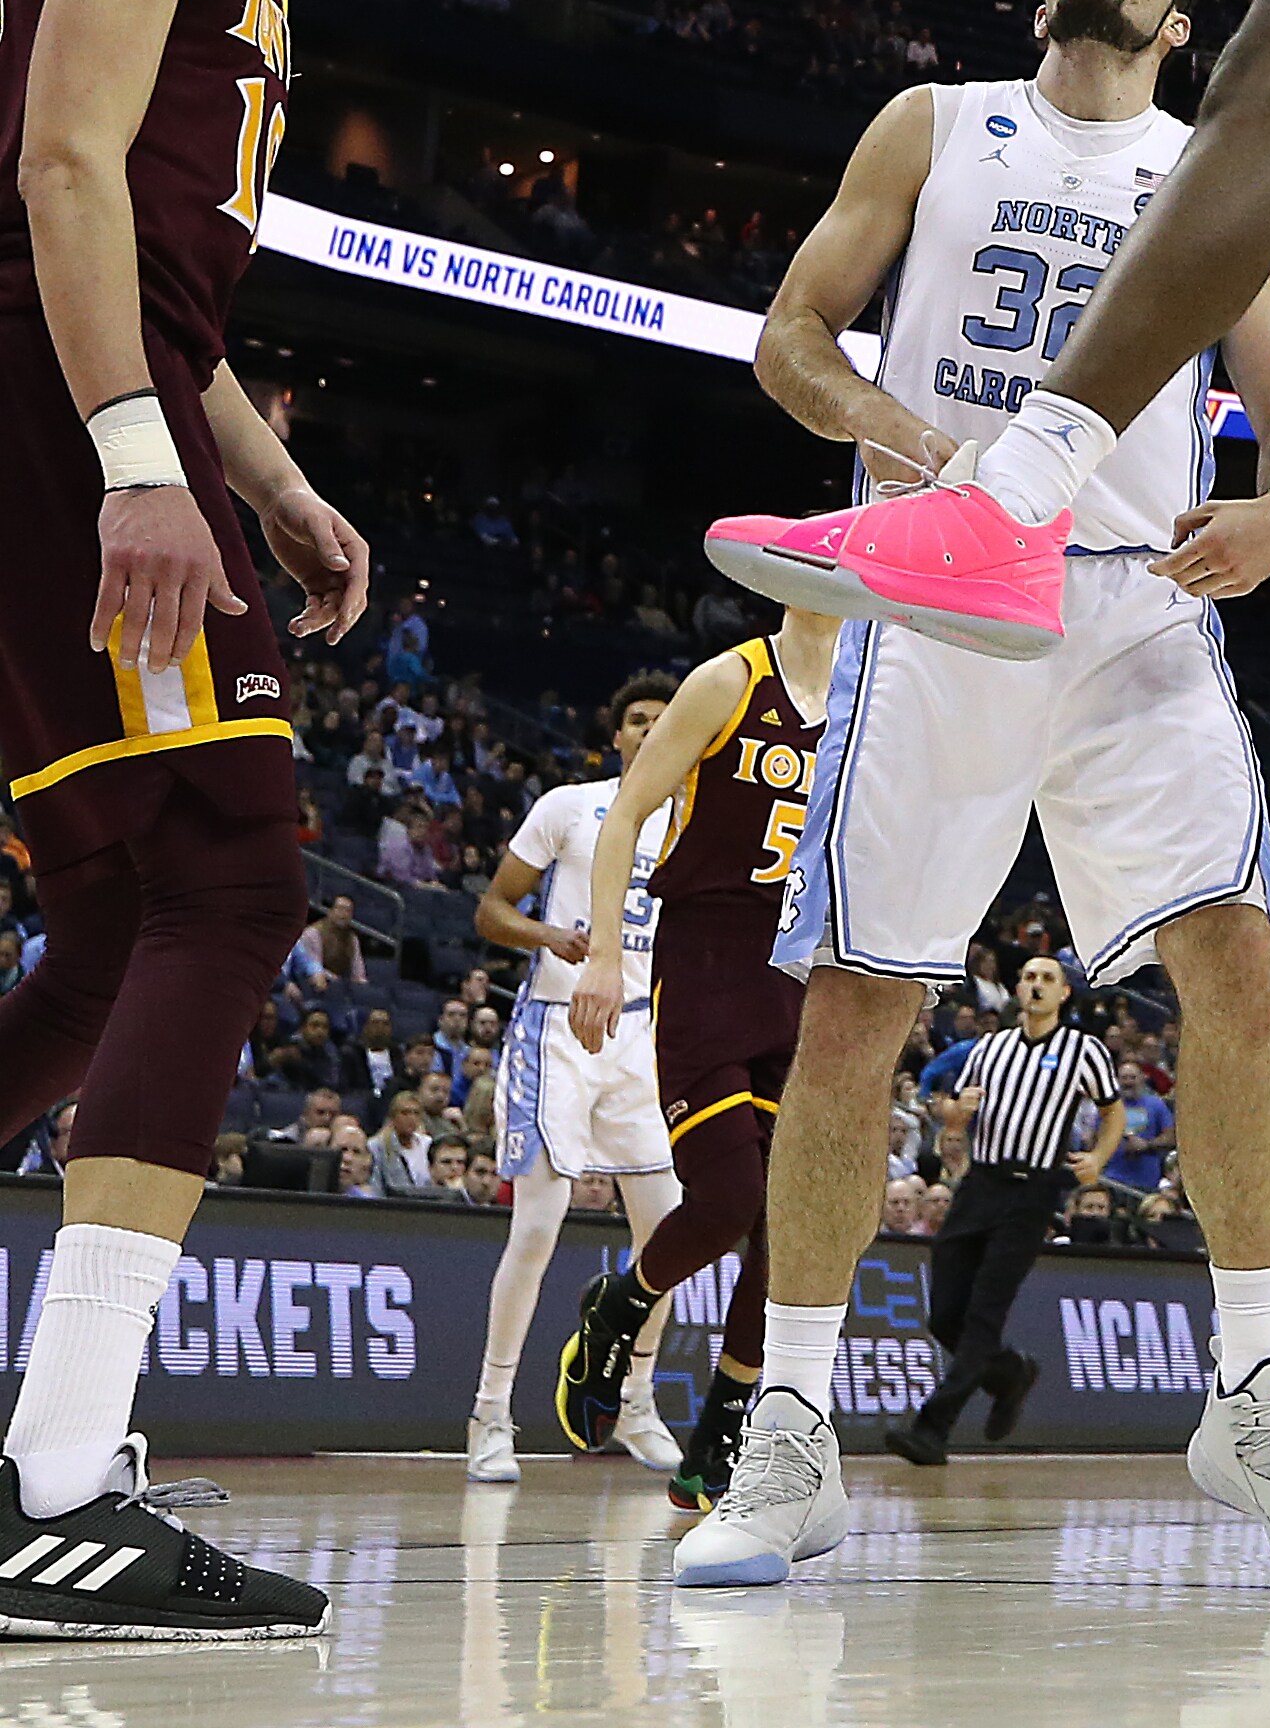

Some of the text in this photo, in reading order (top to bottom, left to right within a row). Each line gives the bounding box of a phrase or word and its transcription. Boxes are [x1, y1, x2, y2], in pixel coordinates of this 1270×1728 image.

[329, 225, 665, 331] IONA VS NORTH CAROLINA
[934, 358, 1041, 413] CARO
[236, 673, 280, 703] MAAC
[733, 737, 817, 795] IO
